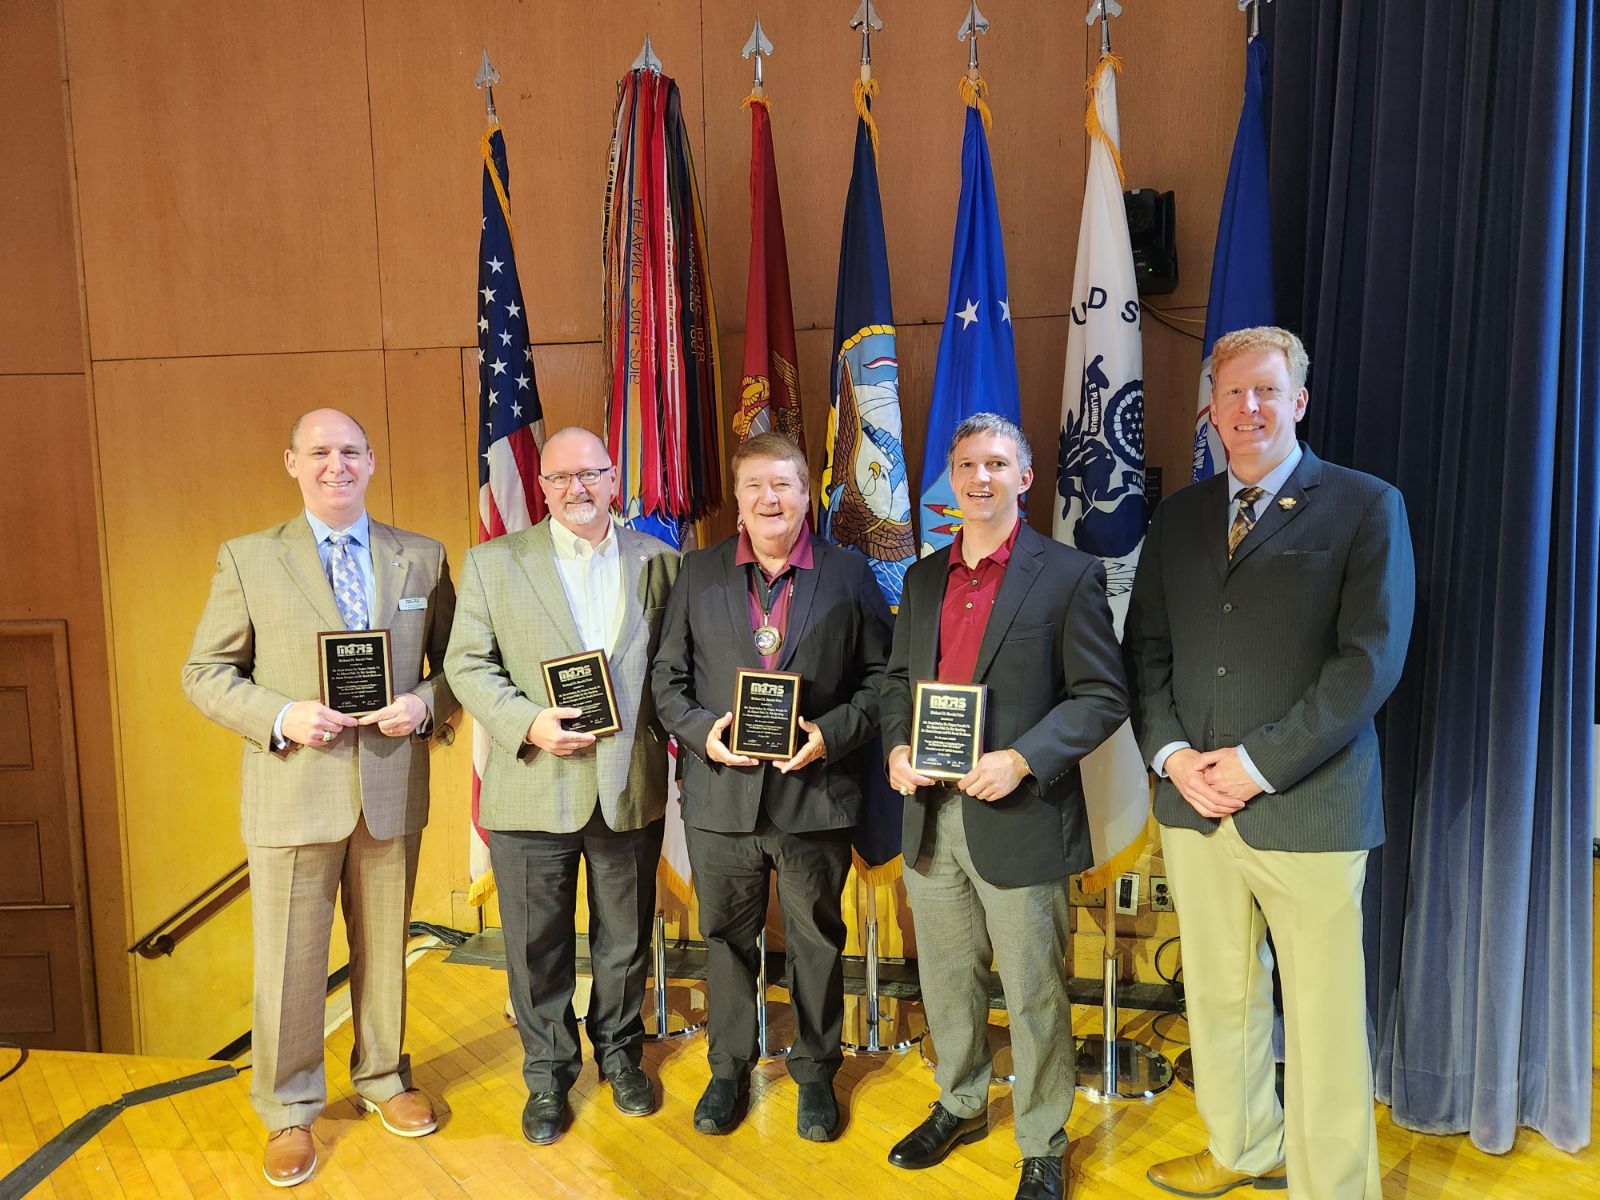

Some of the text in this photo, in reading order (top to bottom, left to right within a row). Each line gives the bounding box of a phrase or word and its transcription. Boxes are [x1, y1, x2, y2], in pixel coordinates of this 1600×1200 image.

[1090, 391, 1099, 432] PLURIBUS
[336, 643, 373, 655] MORS
[750, 682, 784, 695] MORS
[930, 695, 967, 709] MORS
